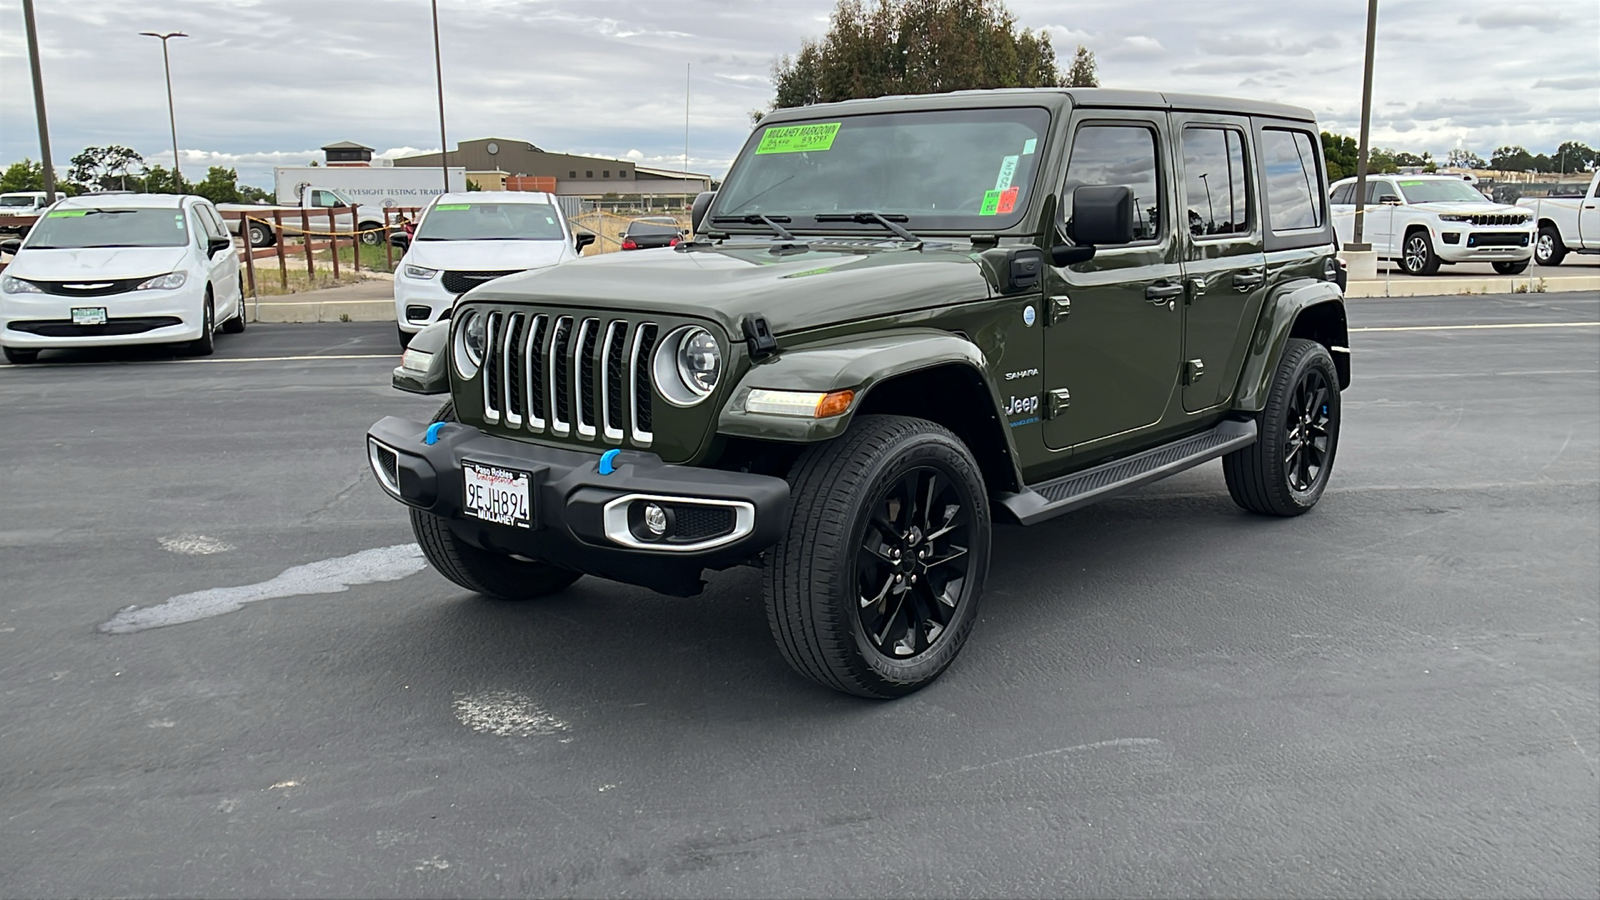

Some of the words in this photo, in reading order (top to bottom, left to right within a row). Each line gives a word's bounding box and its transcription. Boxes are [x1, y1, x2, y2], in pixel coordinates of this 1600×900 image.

[348, 188, 384, 196] EYESIGHT
[387, 188, 417, 196] TESTING
[419, 188, 445, 196] TRAILE
[1005, 368, 1039, 380] SAHARA
[1005, 395, 1039, 416] Jeep
[475, 464, 491, 476] Paso
[491, 468, 514, 480] Robles
[468, 483, 528, 520] 9EJH894
[477, 508, 516, 527] MULLAHEY
